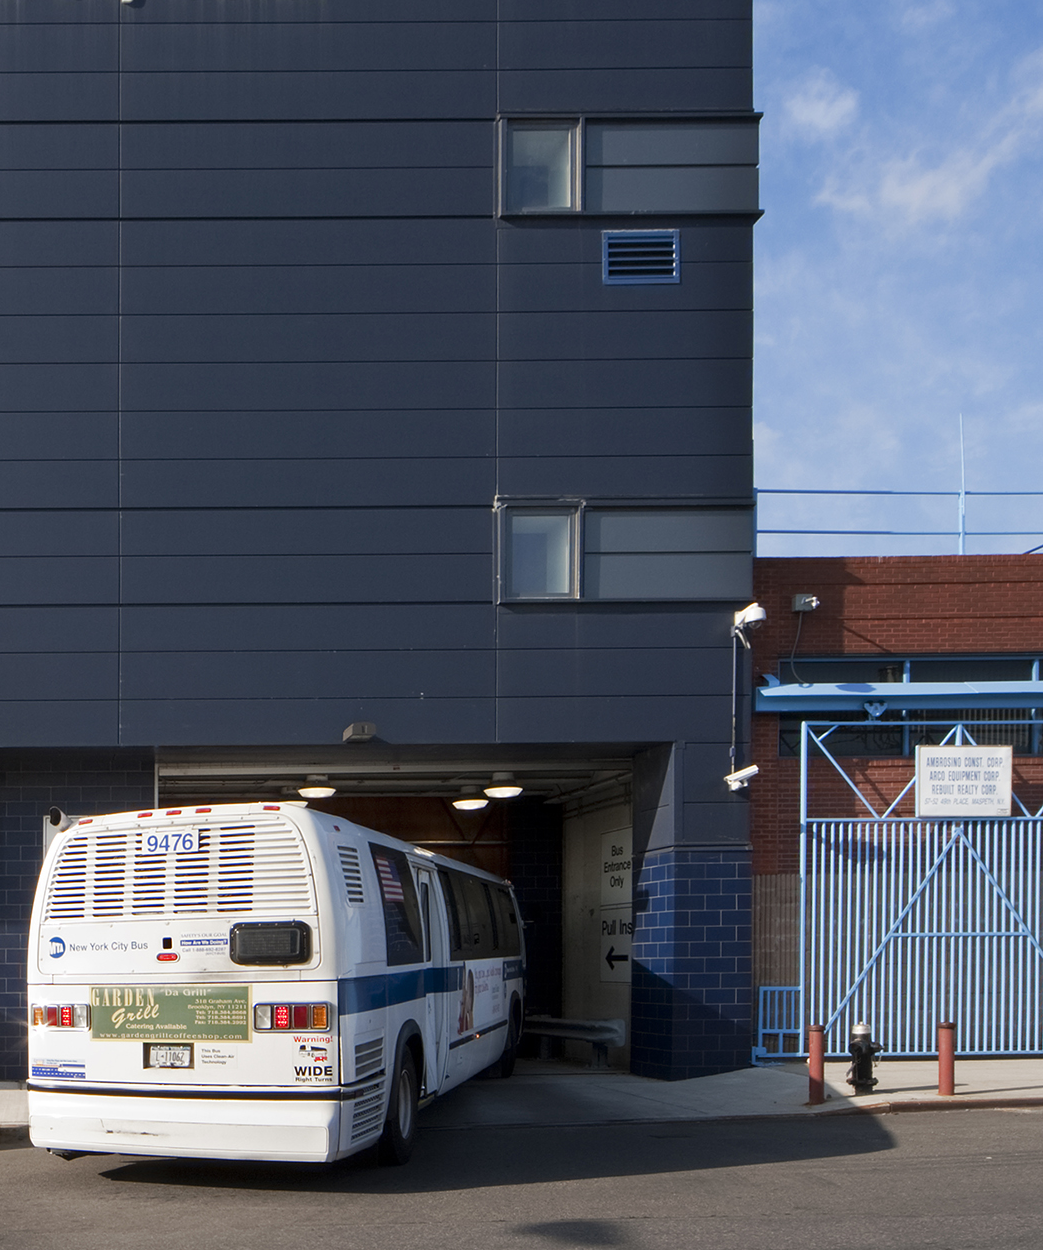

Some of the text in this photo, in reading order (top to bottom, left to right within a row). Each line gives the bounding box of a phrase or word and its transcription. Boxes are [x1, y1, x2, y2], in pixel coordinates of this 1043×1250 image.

[926, 757, 1005, 768] AMBROSINO CONST. CORP.
[929, 770, 1001, 782] ARCO EQUIPMENT CORP.
[931, 784, 999, 795] REBUILT REALTY CORP.
[146, 833, 194, 852] 9476
[611, 845, 624, 857] Bus
[603, 859, 631, 873] Entrance
[609, 876, 624, 889] Only
[601, 919, 633, 936] Pull Ins
[69, 940, 149, 953] New York City Bus
[92, 988, 155, 1007] GARDEN
[111, 1004, 160, 1029] Grill
[99, 1032, 243, 1040] www.gardengrillcoffeeshop.com
[293, 1036, 333, 1045] Warning!
[294, 1066, 333, 1077] WIDE
